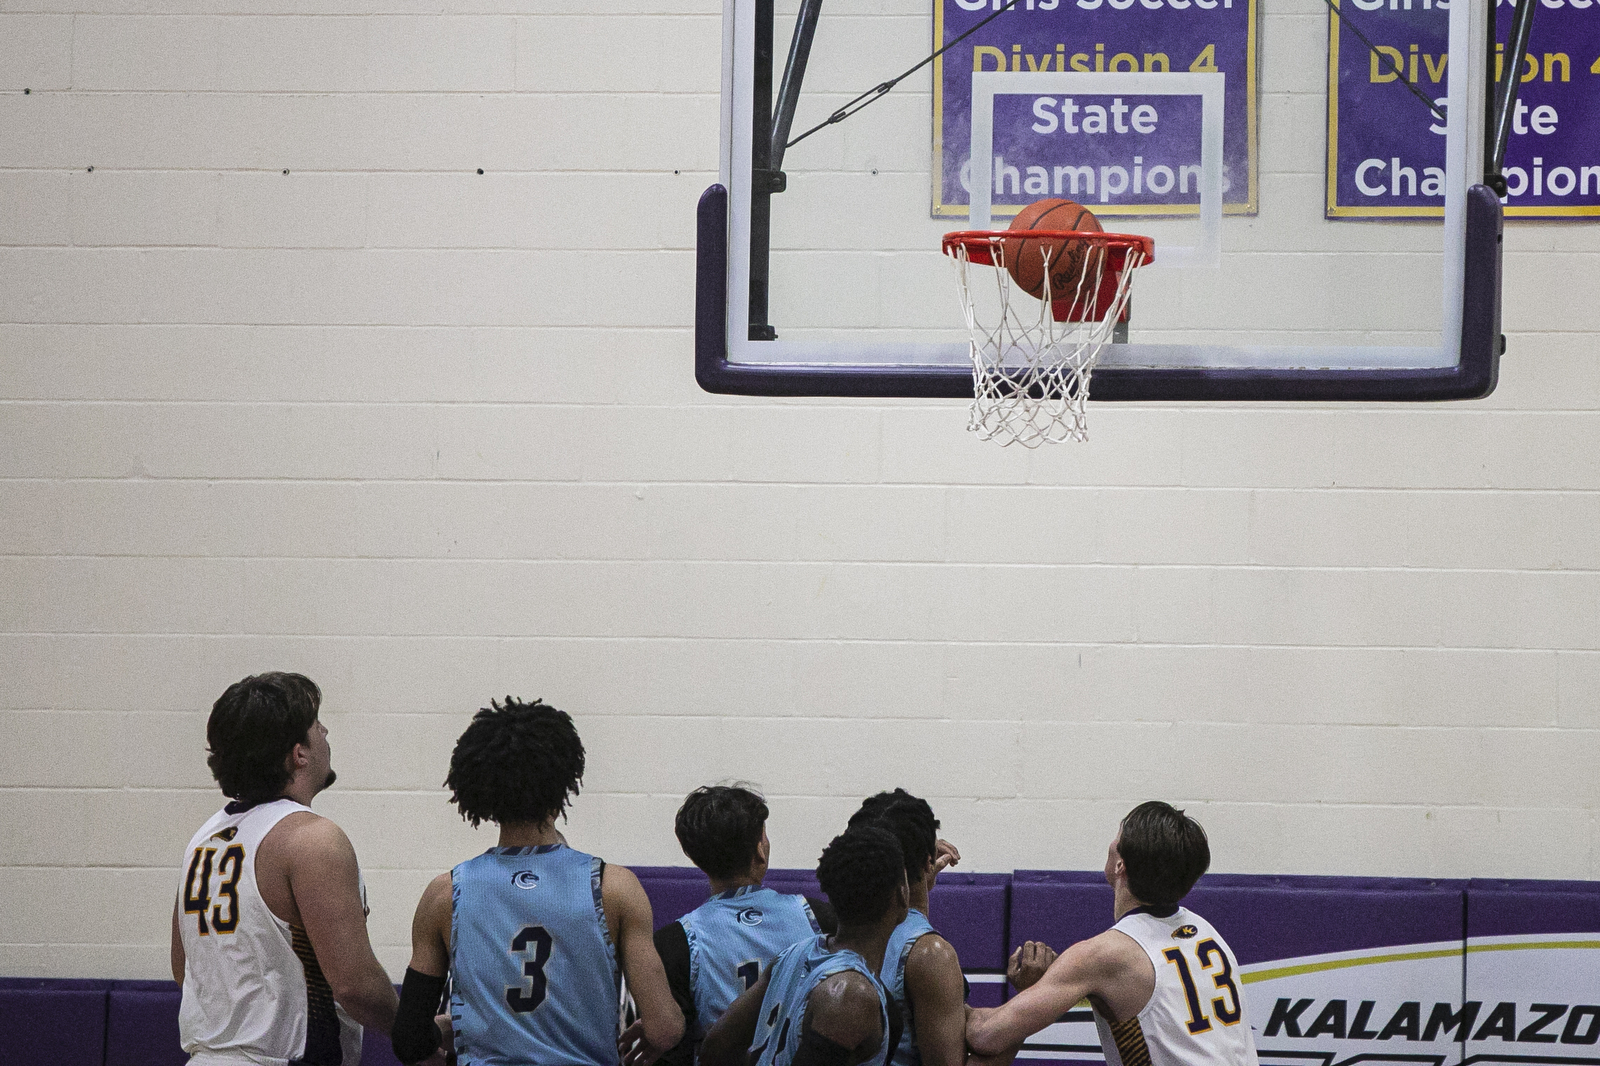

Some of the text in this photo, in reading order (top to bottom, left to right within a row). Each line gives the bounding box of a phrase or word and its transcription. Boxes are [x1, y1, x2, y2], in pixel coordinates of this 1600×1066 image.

[1031, 97, 1158, 134] State
[1429, 97, 1559, 136] Ste
[1354, 157, 1600, 204] Chapion
[183, 843, 246, 937] 43
[504, 925, 553, 1014] 3
[1161, 937, 1242, 1036] 13
[1262, 997, 1600, 1045] KALAMAZO
